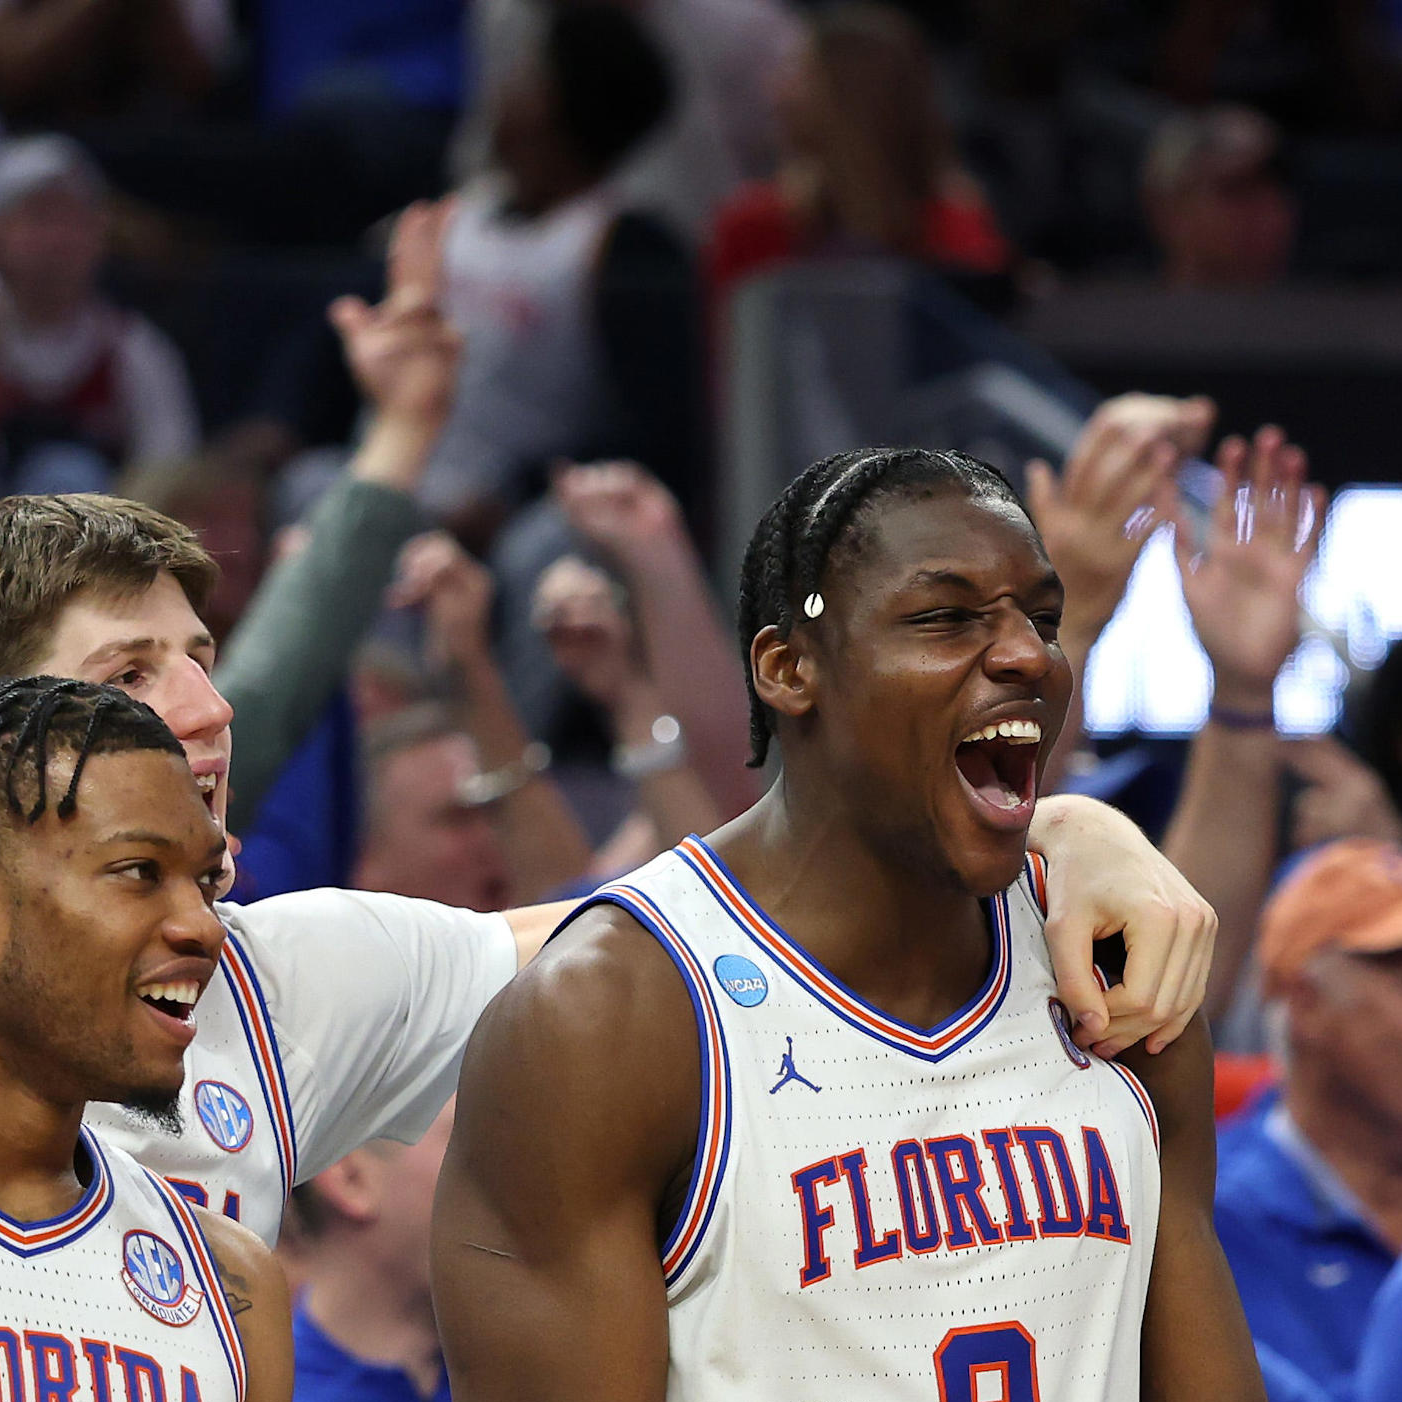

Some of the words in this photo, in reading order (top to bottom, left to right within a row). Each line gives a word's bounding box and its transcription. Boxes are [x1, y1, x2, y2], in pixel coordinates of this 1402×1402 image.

[723, 976, 766, 993] NCAA
[791, 1126, 1131, 1289] FLORIDA
[126, 1233, 181, 1302] SEC
[132, 1286, 196, 1324] GRADUATE
